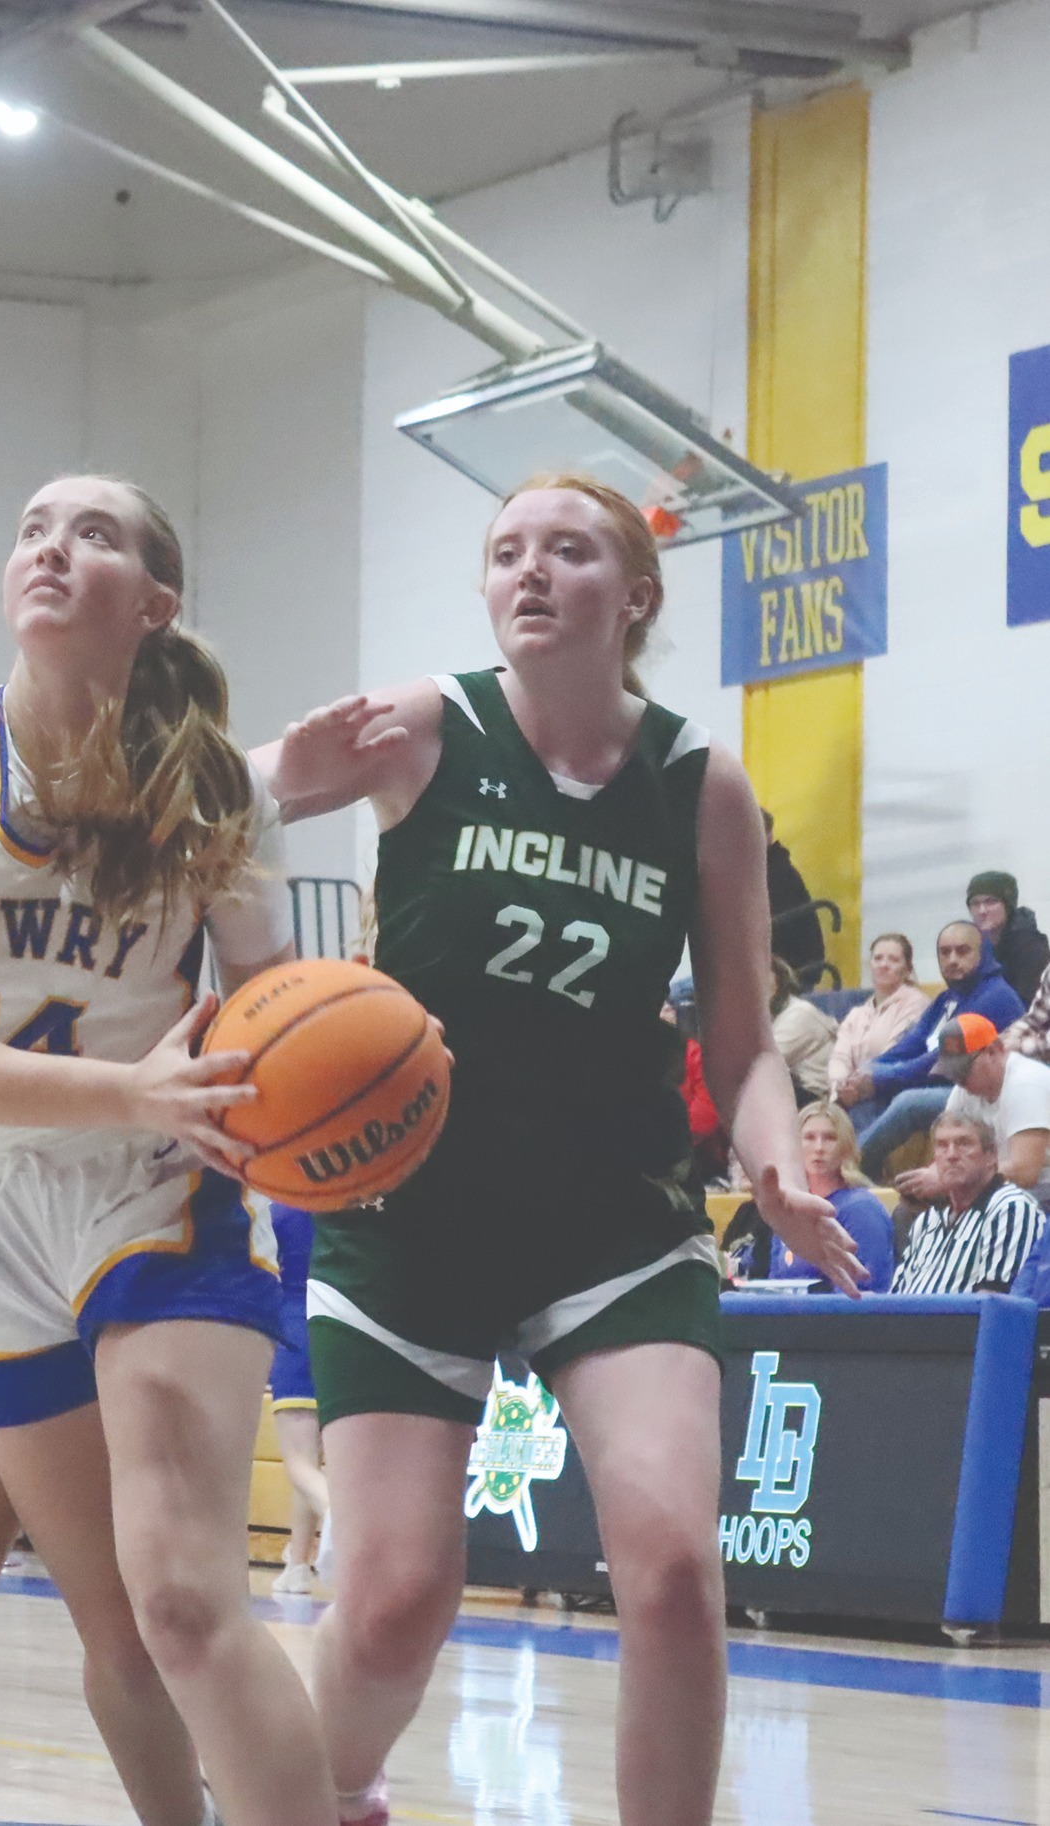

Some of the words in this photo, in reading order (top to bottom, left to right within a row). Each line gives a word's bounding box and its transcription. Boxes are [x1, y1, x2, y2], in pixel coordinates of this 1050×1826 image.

[740, 483, 870, 583] VISITOR
[759, 576, 845, 667] FANS
[453, 825, 667, 917] INCLINE
[484, 904, 610, 1009] 22
[294, 1078, 439, 1185] Wilson
[719, 1515, 813, 1569] HOOPS
